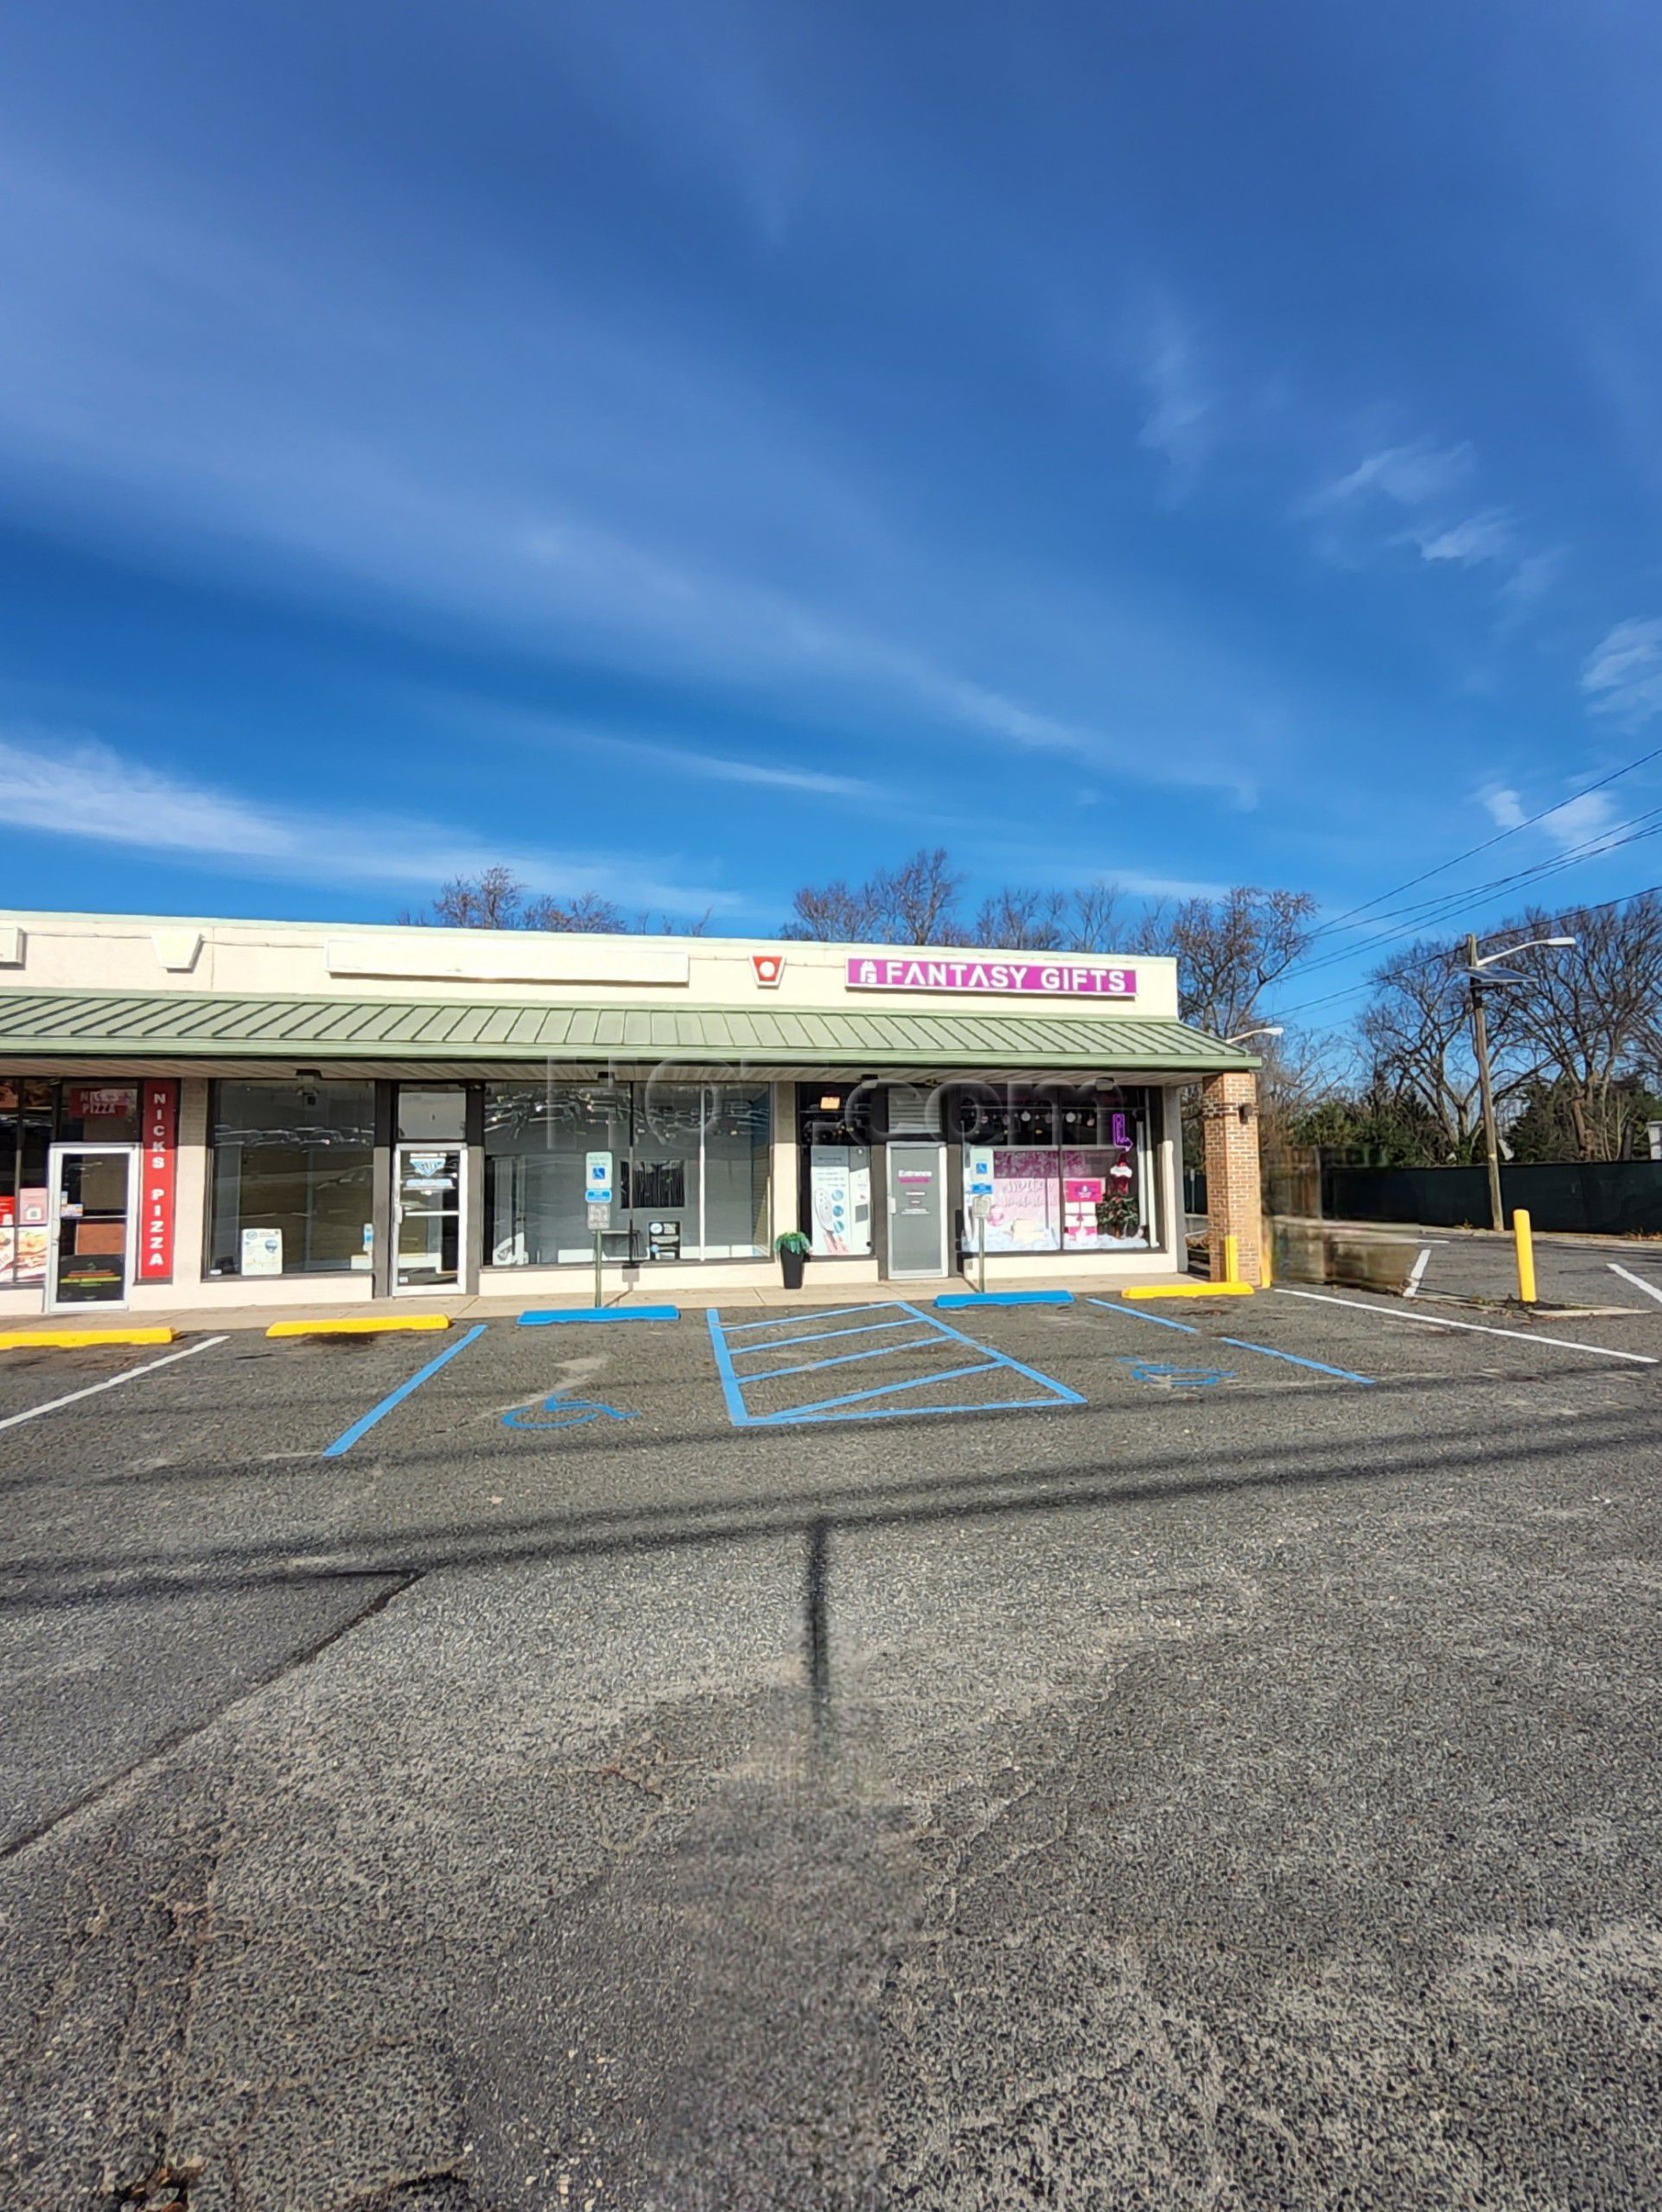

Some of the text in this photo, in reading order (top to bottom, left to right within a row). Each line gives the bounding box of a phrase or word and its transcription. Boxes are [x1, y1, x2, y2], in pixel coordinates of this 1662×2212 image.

[886, 961, 1126, 992] FANTASY GIFTS
[150, 1189, 164, 1266] PIZZA
